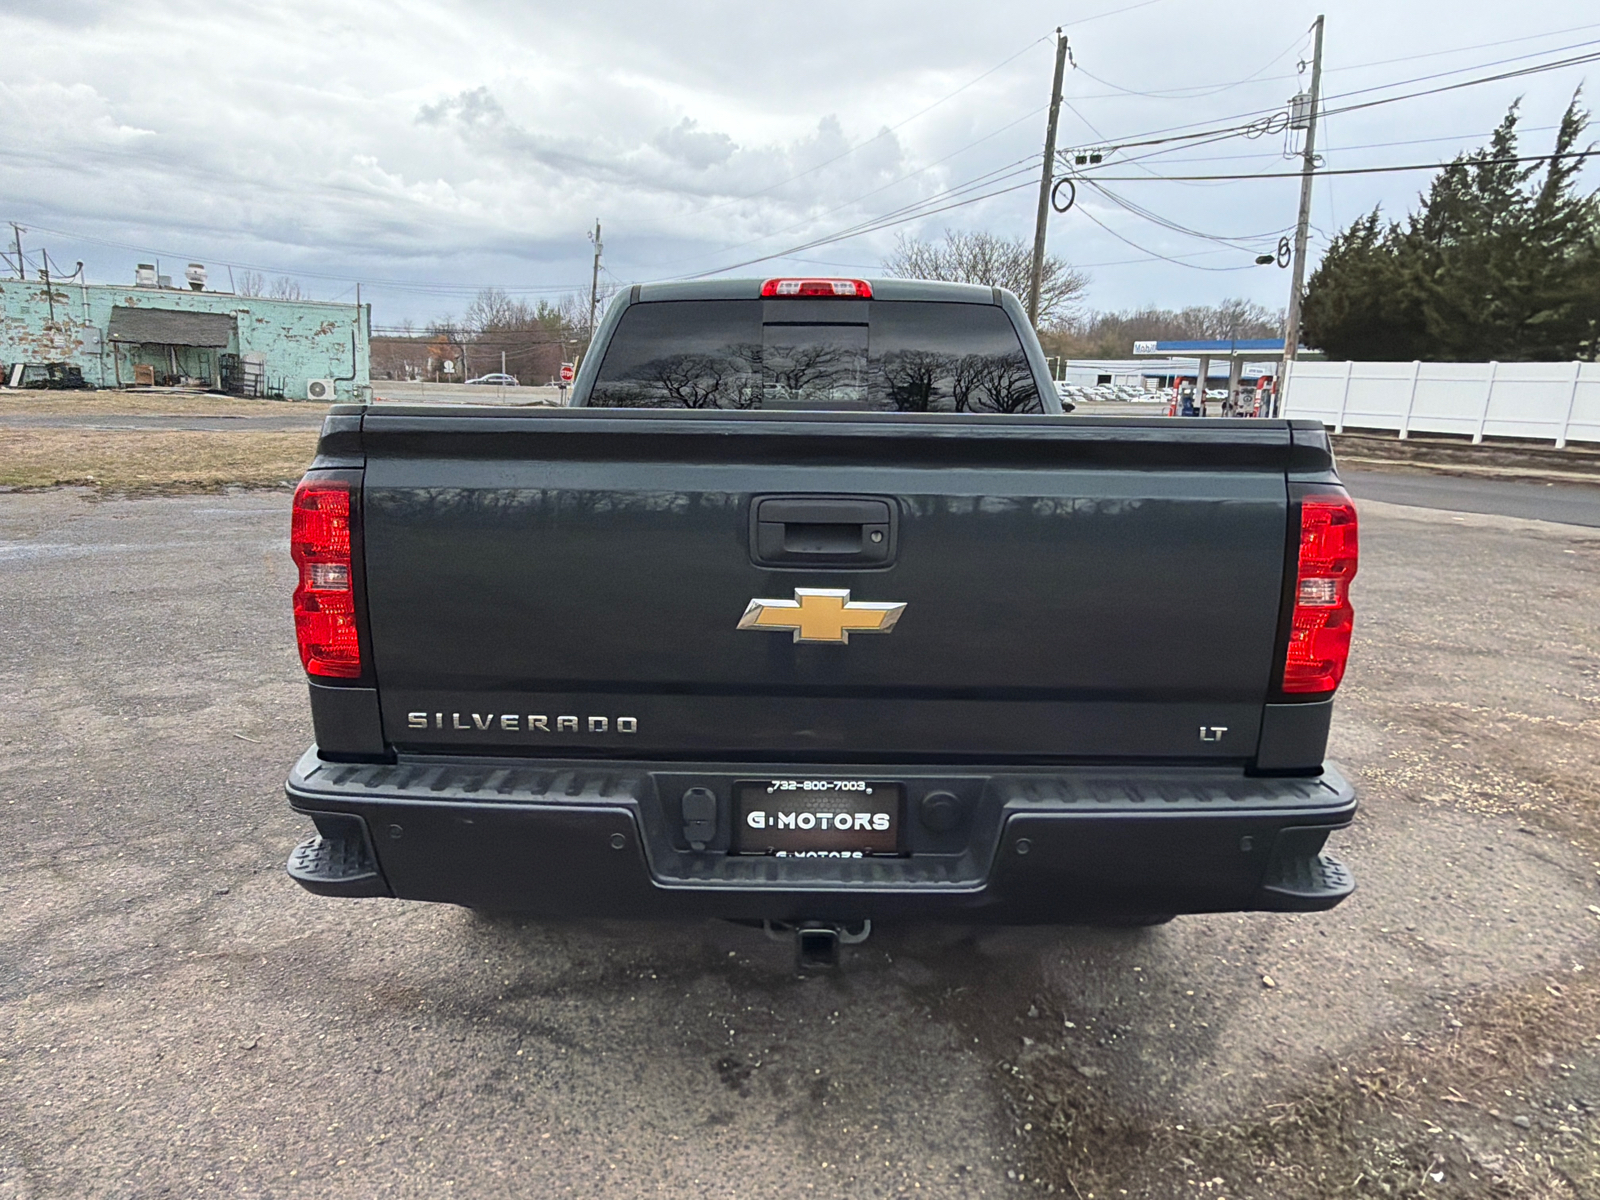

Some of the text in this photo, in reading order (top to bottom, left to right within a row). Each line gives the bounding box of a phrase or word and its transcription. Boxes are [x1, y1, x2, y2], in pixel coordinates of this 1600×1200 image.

[408, 712, 638, 733] SILVERADO
[1199, 726, 1228, 741] LT
[771, 780, 866, 791] 732-800-7003
